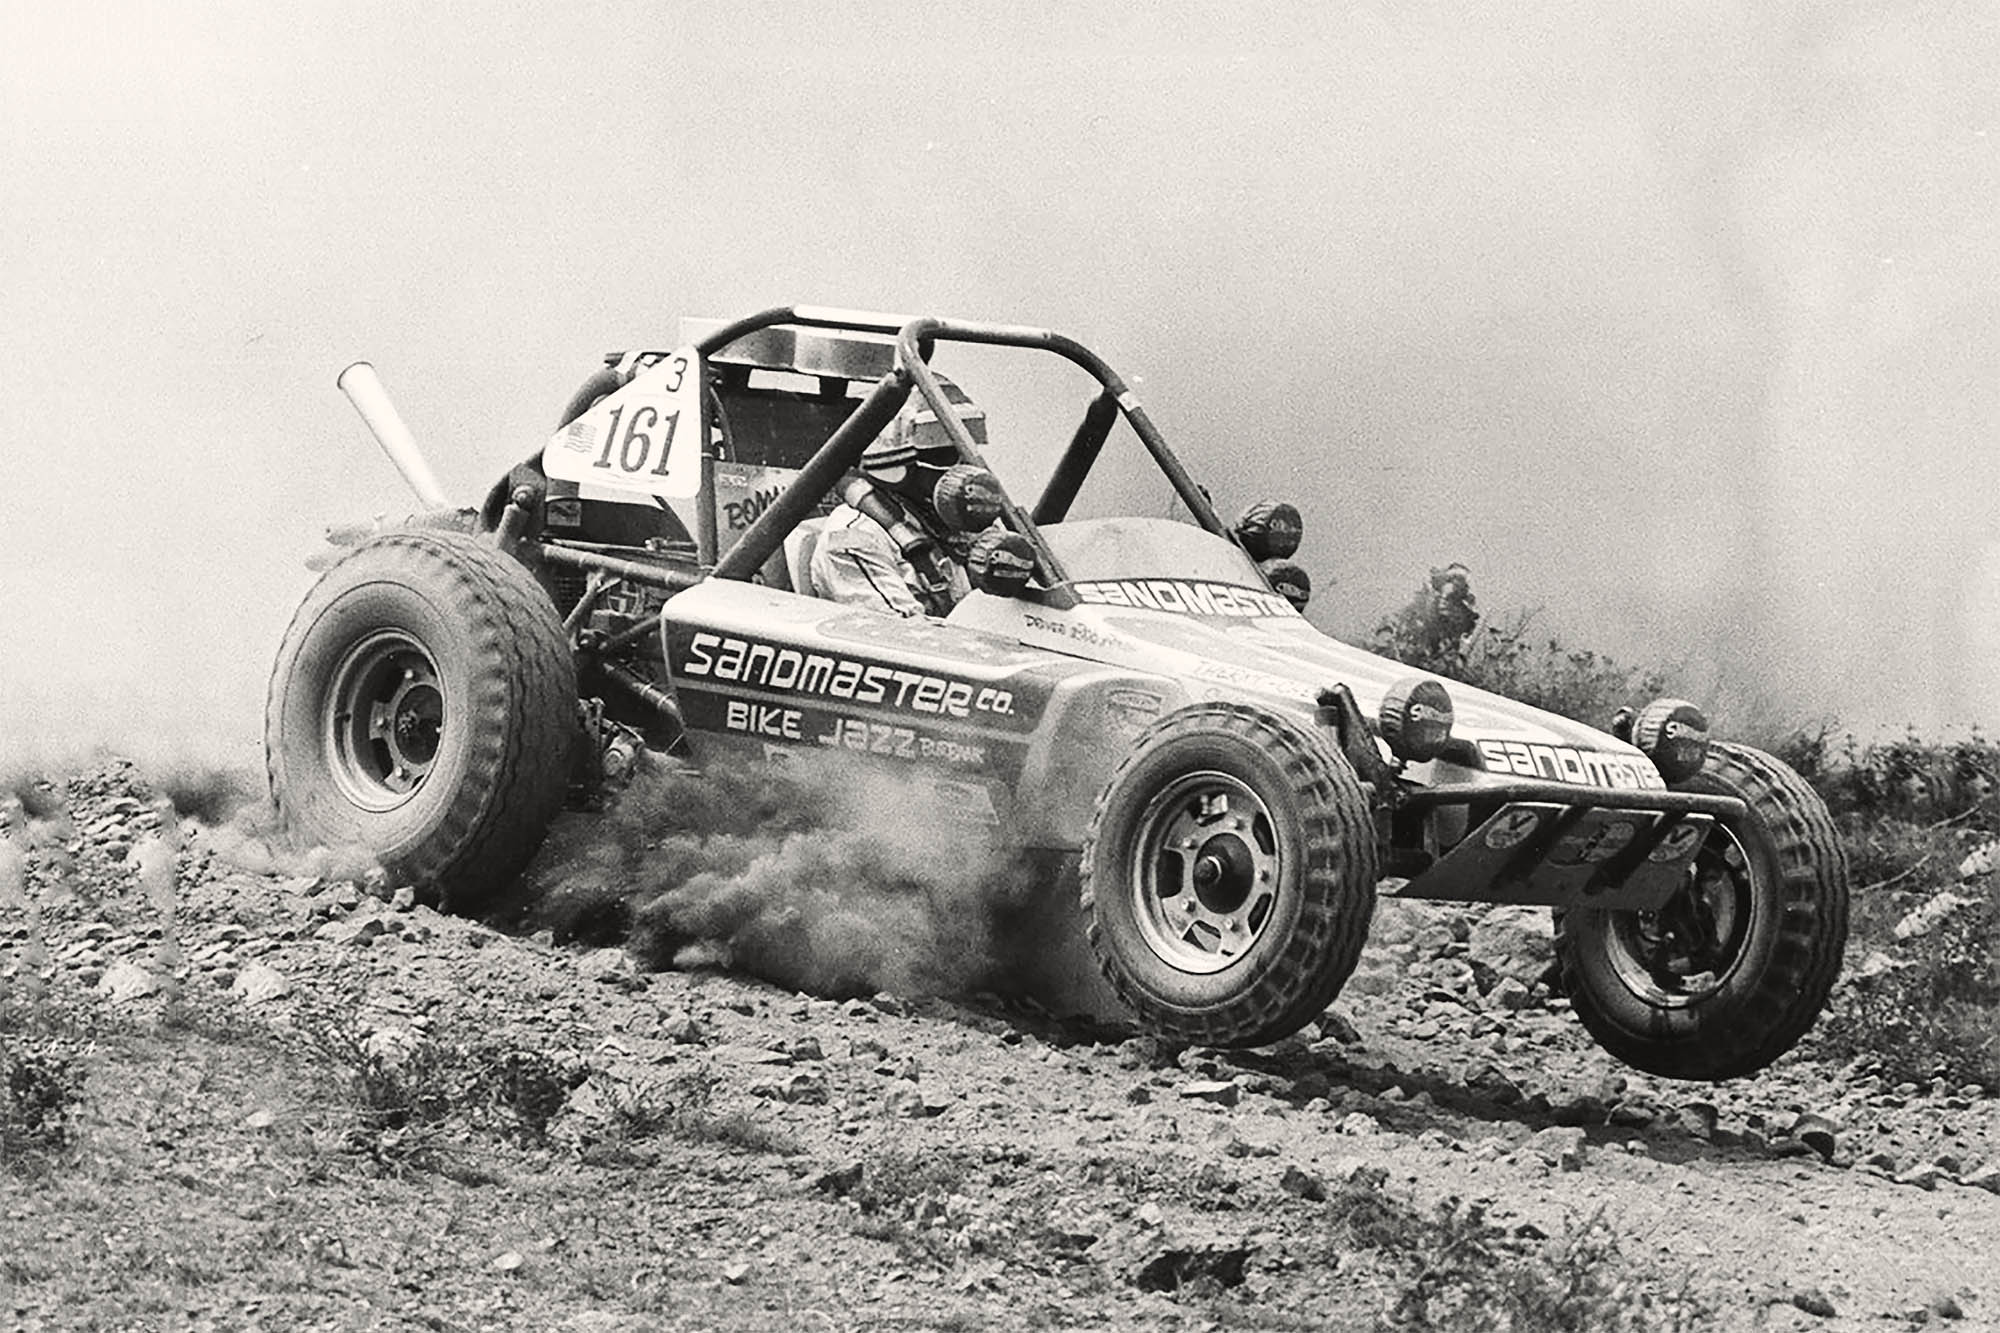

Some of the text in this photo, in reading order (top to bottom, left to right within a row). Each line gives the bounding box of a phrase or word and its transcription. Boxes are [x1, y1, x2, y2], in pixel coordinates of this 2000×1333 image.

[665, 357, 688, 393] 3
[593, 404, 681, 477] 161
[727, 701, 803, 740] BIKE
